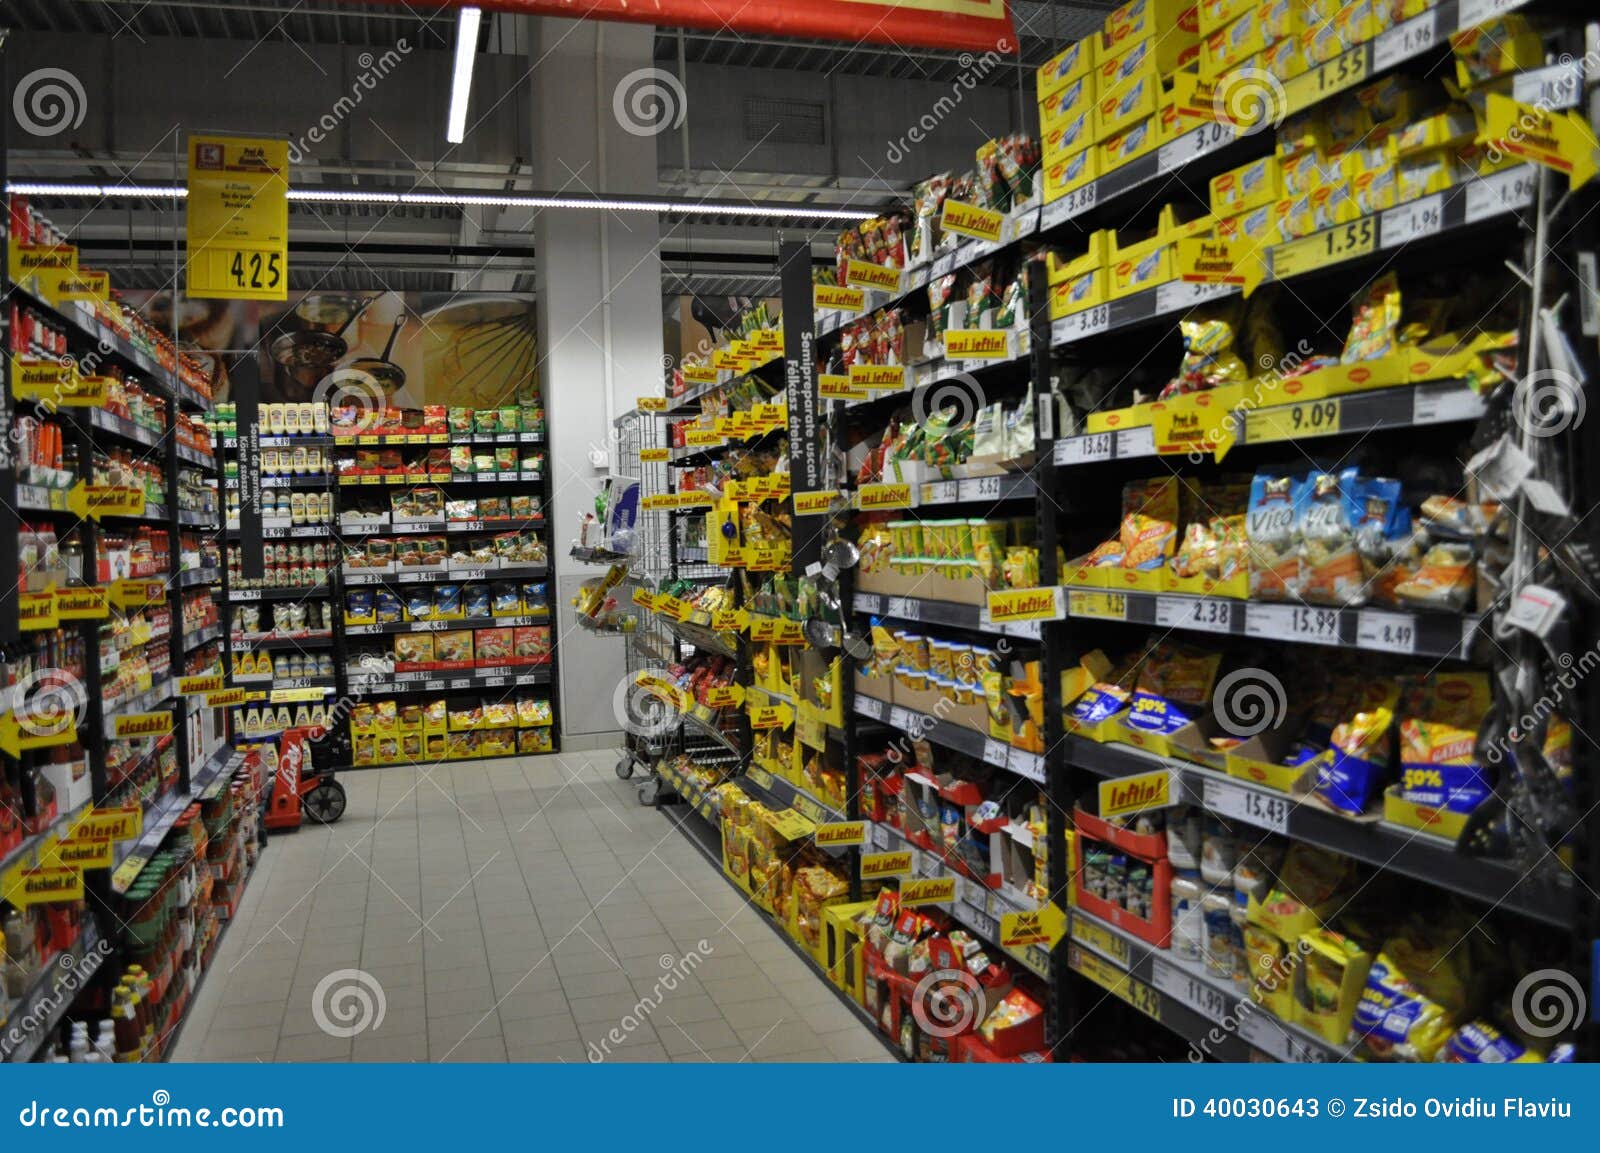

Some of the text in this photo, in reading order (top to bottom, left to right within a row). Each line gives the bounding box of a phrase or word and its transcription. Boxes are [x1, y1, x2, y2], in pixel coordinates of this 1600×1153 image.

[1402, 26, 1432, 52] 1.96
[1317, 50, 1363, 91] 1.55
[1068, 184, 1095, 212] 3.88
[1500, 173, 1534, 202] 1.96
[1410, 208, 1440, 233] 1.96
[1325, 221, 1372, 256] 1.55
[230, 251, 280, 289] 4.25
[1080, 306, 1107, 331] 3.88
[948, 341, 968, 351] mai
[787, 359, 803, 460] Félkész ételek
[800, 331, 817, 487] Semipreparate uscate
[1291, 403, 1338, 430] 9.09
[250, 423, 259, 452] Sosuri
[1081, 433, 1110, 456] 13.62
[251, 455, 261, 466] de
[1193, 600, 1229, 624] 2.38
[1293, 608, 1337, 636] 15.99
[1383, 624, 1412, 645] 8.49
[1245, 792, 1286, 823] 15.43
